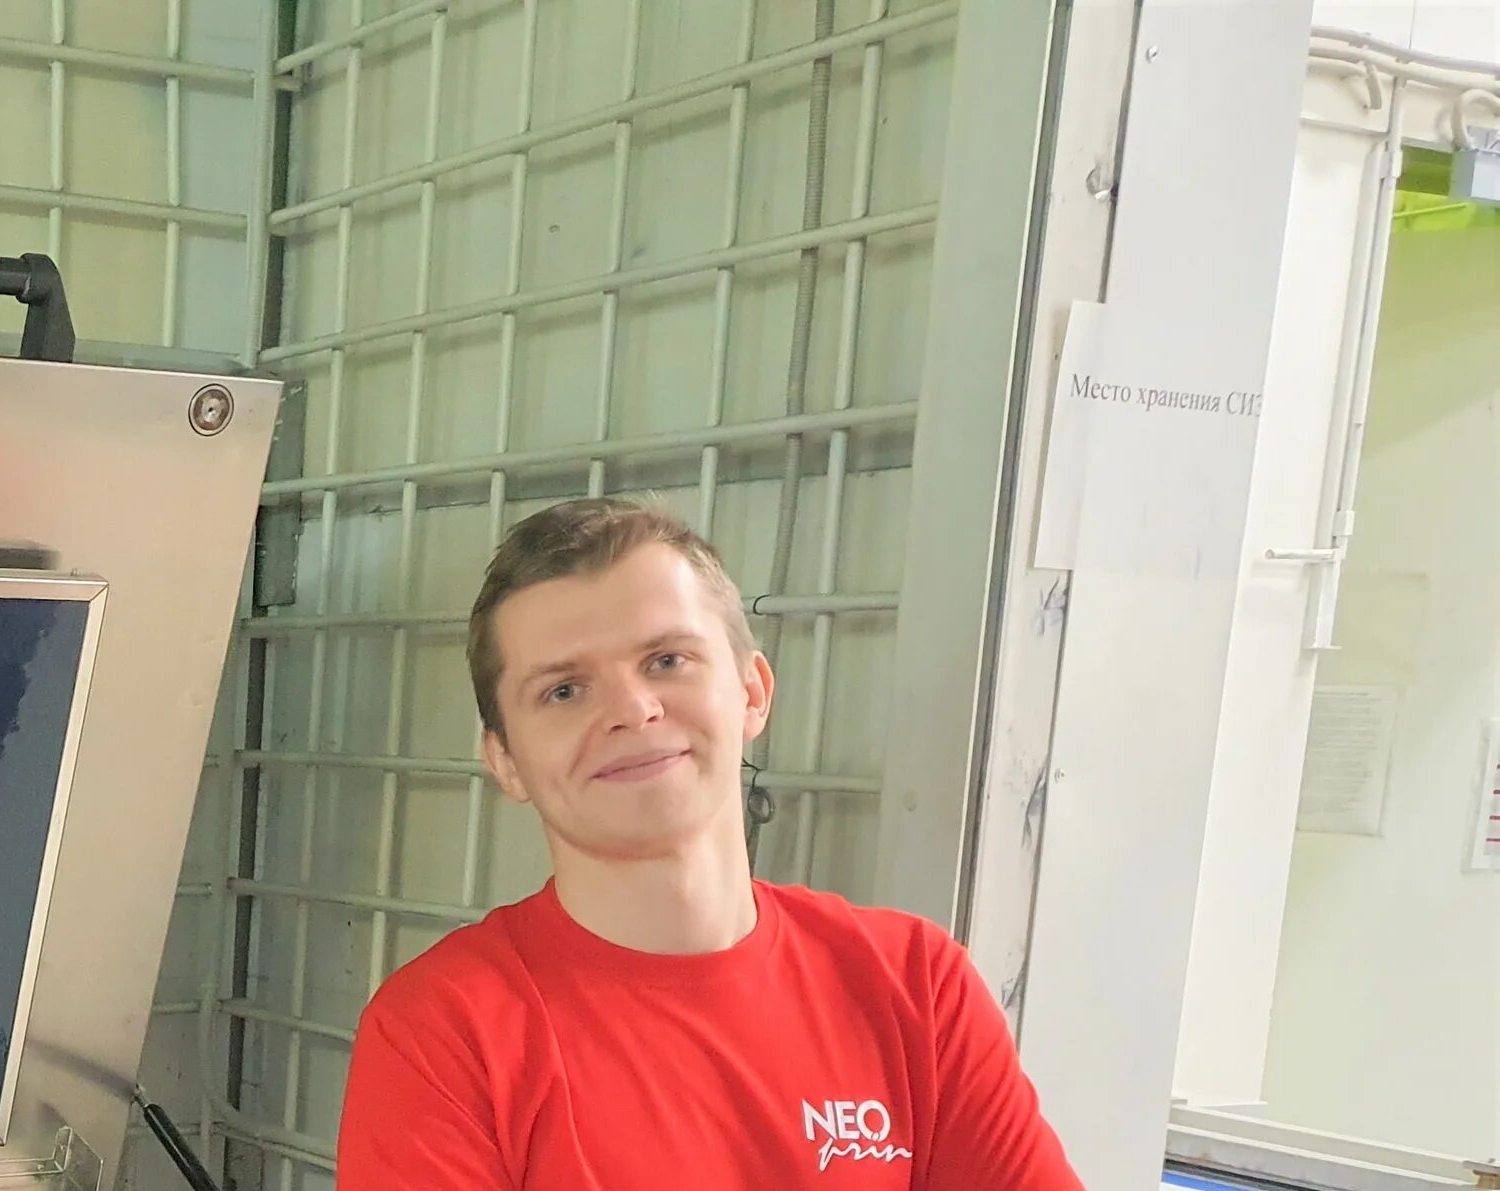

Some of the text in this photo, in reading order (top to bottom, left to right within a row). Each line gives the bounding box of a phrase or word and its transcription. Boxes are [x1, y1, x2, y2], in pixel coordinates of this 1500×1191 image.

[1069, 373, 1132, 403] Место
[1135, 386, 1221, 412] хранения
[801, 1099, 891, 1142] NEO
[817, 1137, 914, 1172] prin
